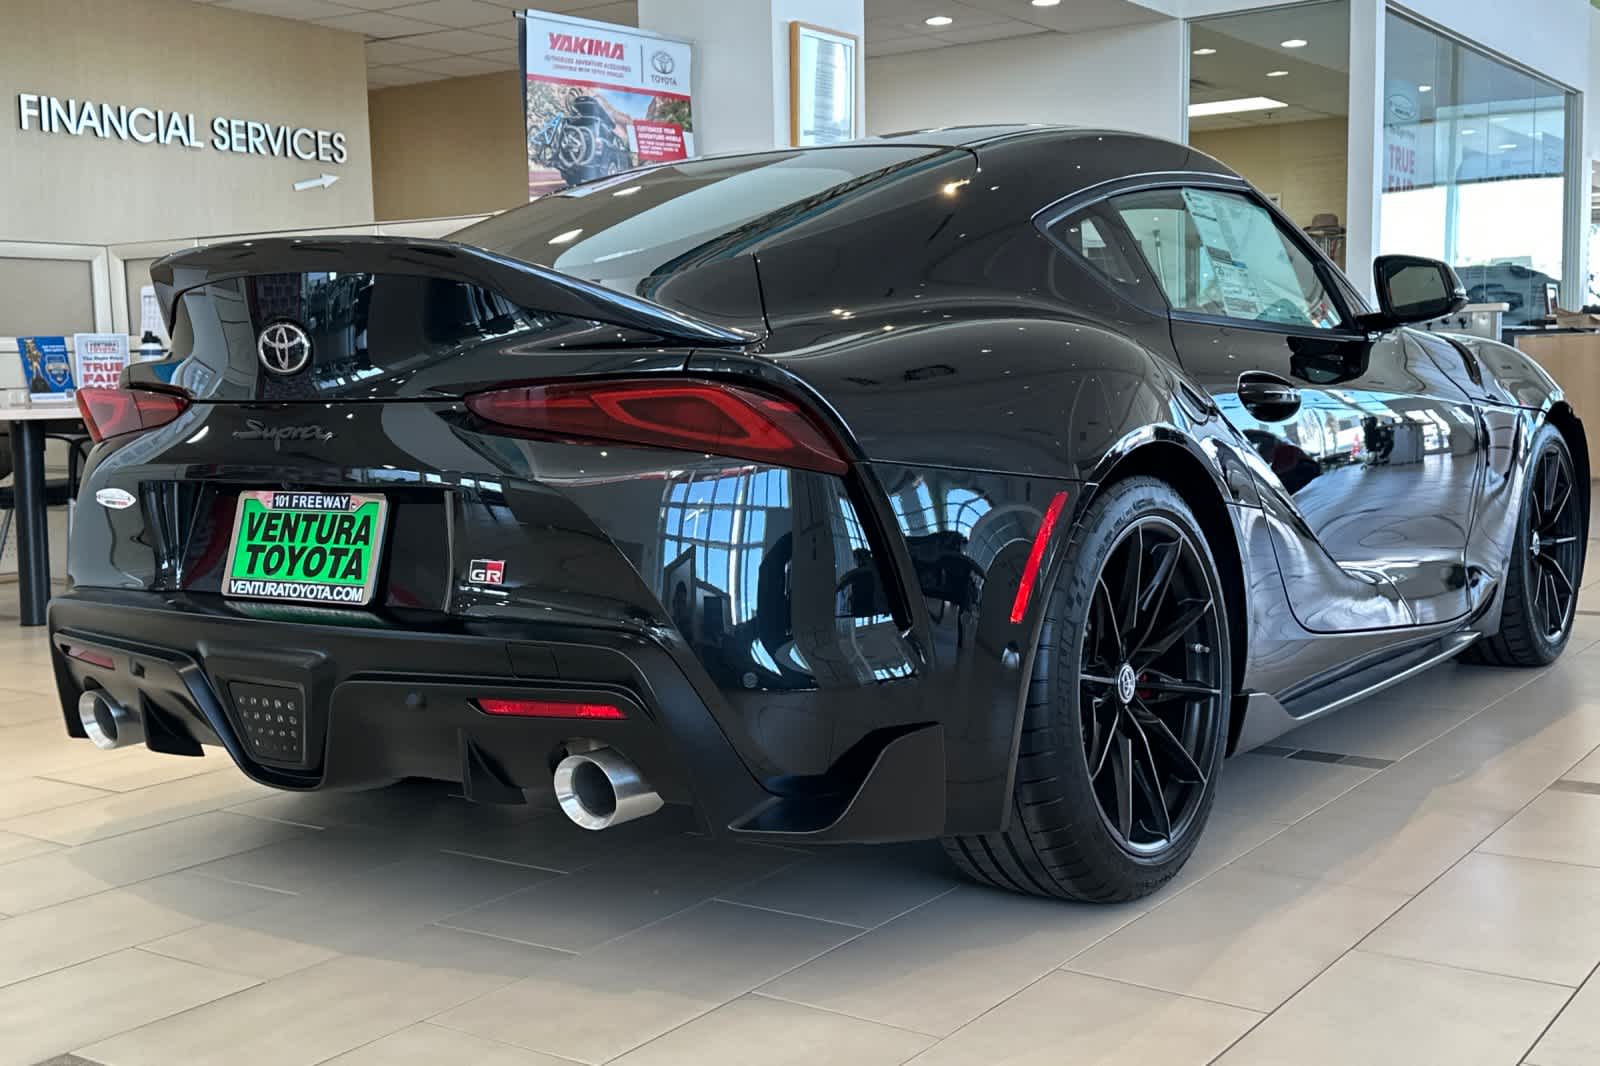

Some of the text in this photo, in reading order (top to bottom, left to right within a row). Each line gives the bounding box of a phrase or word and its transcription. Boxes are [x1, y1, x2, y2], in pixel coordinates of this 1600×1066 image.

[548, 32, 625, 61] YAKIMA
[651, 74, 677, 86] TOYOTA
[18, 93, 347, 164] FINANCIAL SERVICES
[232, 418, 334, 451] Supra
[274, 495, 349, 509] 101 FREEWAY
[246, 512, 371, 545] VENTURA
[246, 544, 363, 579] TOYOTA
[471, 569, 501, 583] GR
[230, 580, 364, 602] VENTURATOYOTA.COM
